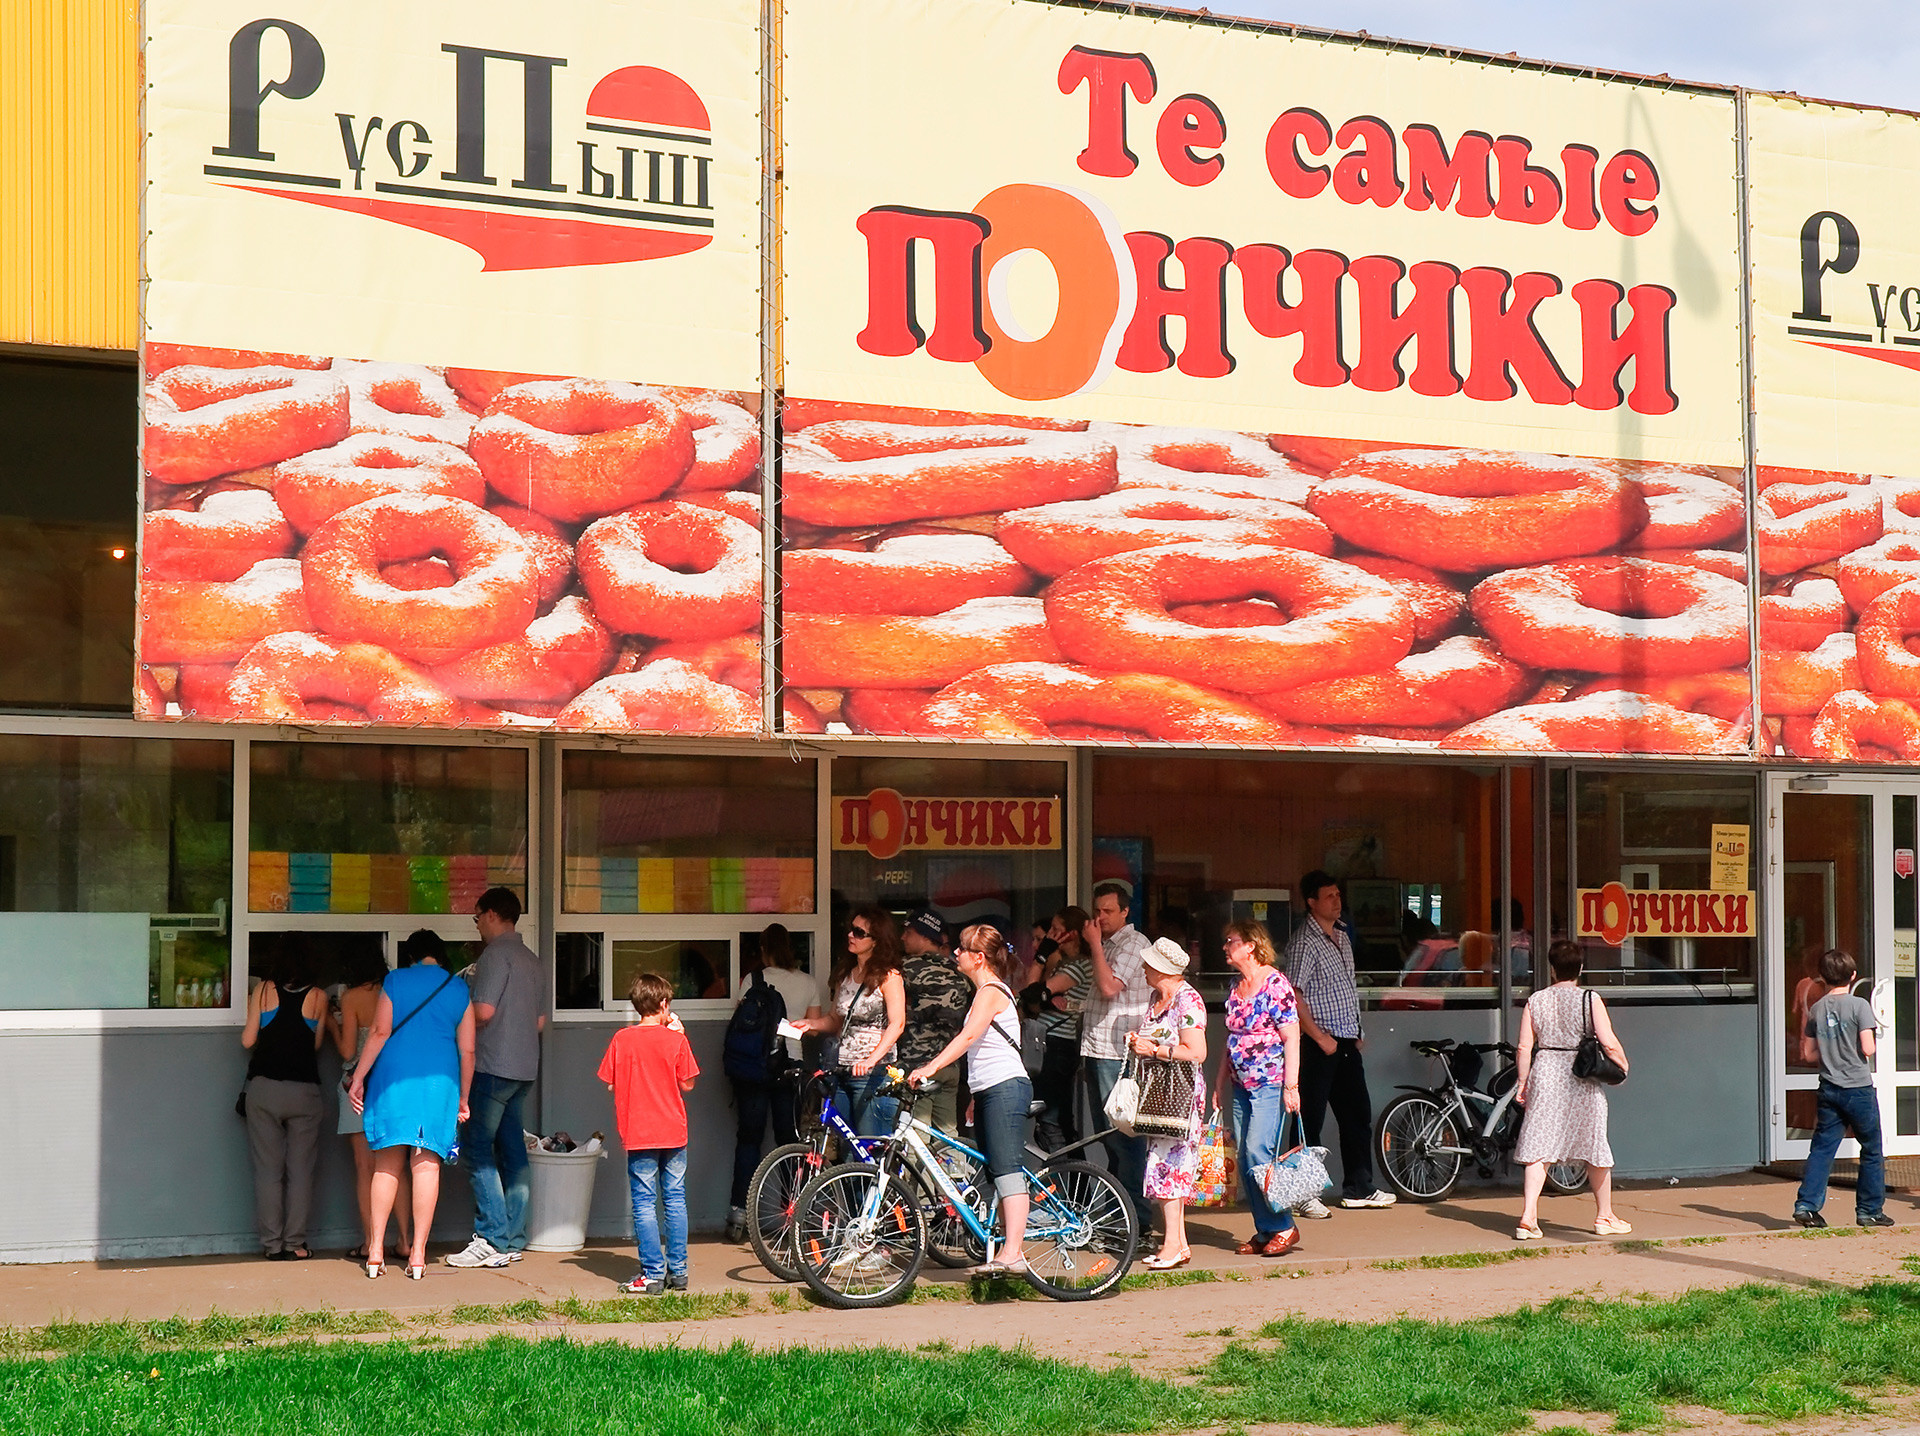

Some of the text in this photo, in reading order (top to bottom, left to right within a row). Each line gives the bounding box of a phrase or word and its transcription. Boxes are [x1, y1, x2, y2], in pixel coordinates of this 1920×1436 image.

[1058, 44, 1661, 237] Те самые
[840, 787, 1053, 860] ПОНЧИКИ
[1582, 881, 1749, 946] ПОНЧИКИ
[832, 1114, 869, 1159] STELS
